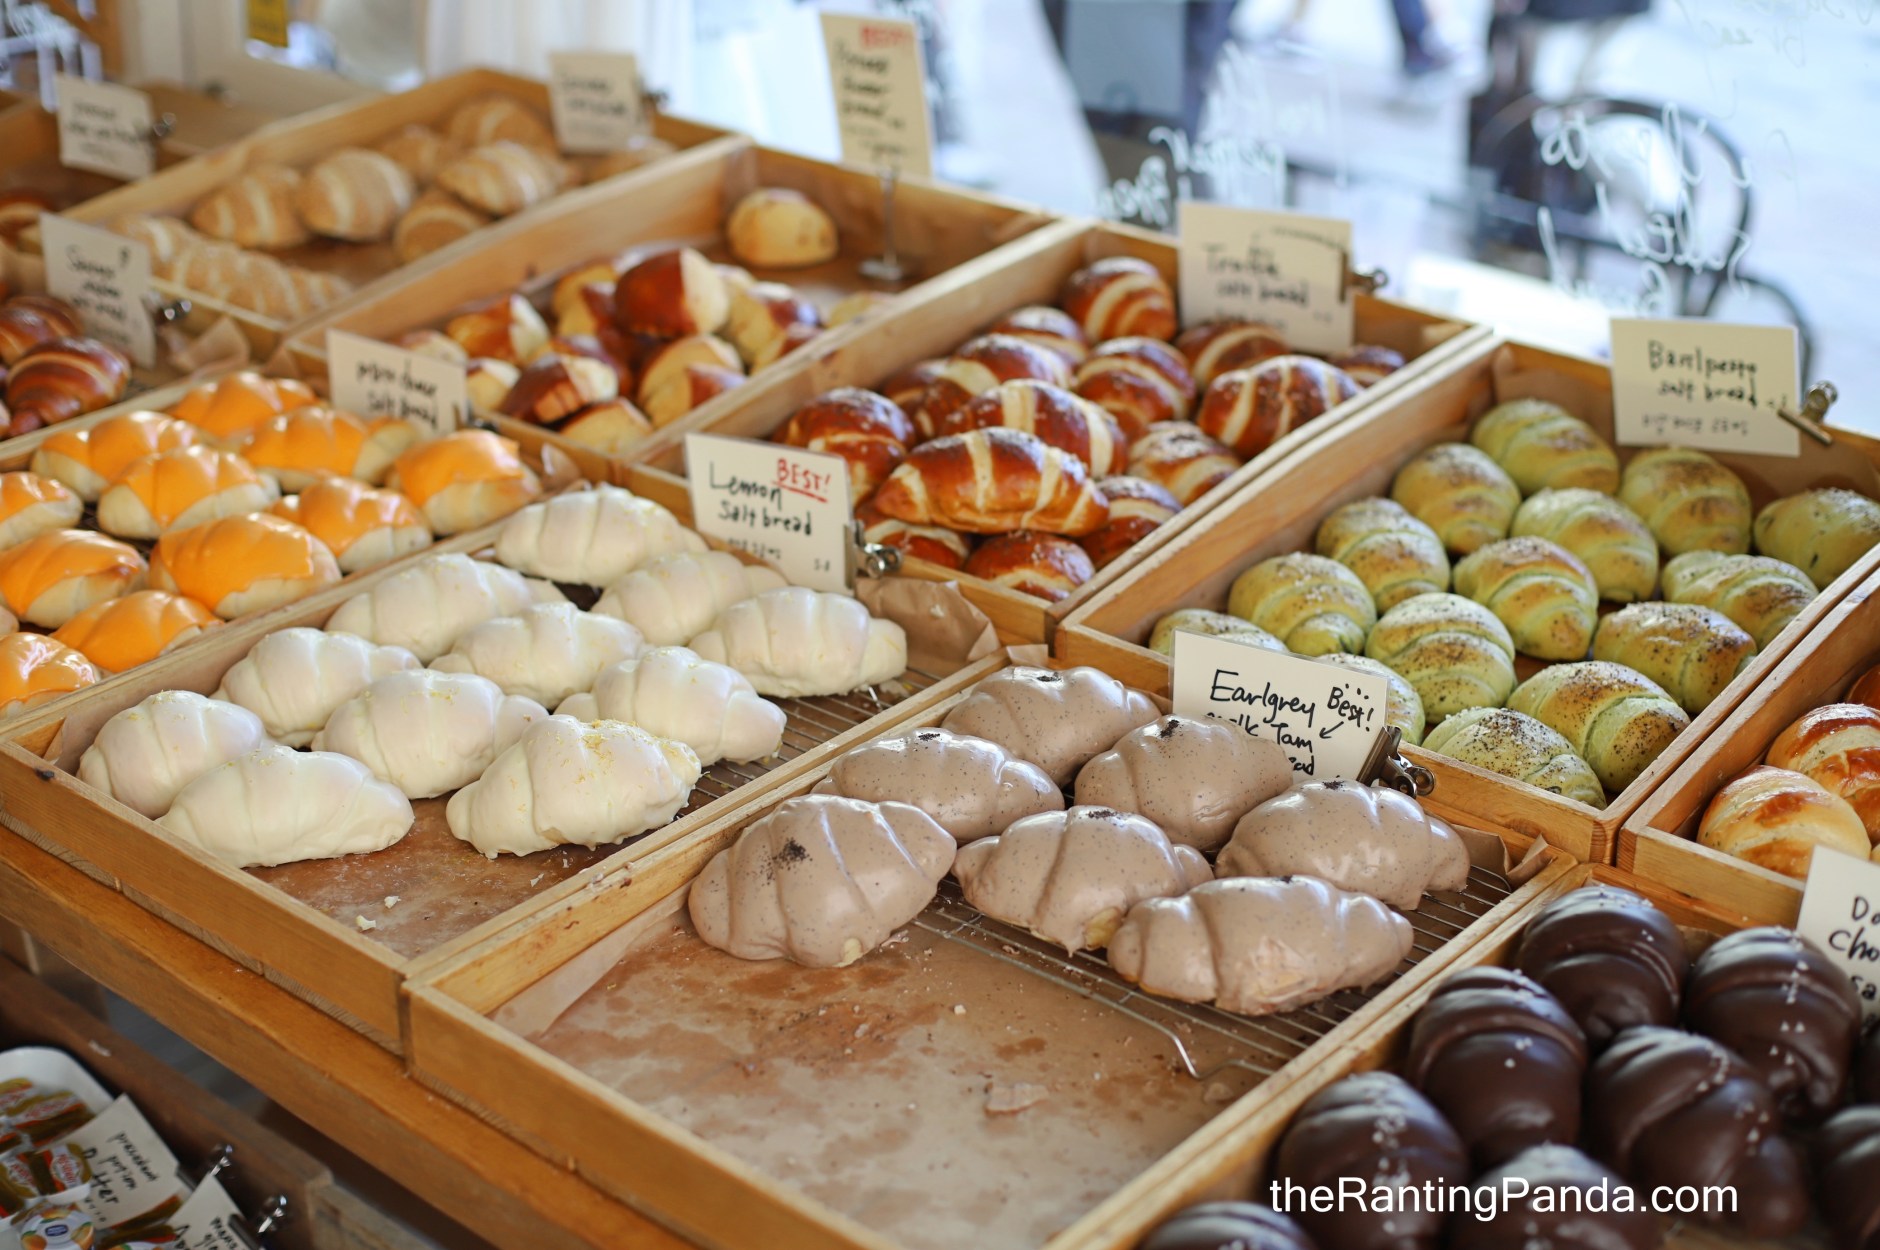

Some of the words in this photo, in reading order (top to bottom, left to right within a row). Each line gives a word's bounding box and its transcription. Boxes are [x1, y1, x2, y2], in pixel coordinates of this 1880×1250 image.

[710, 460, 782, 512] Lemon
[777, 457, 832, 492] BEST!
[718, 500, 756, 528] Salt
[763, 507, 812, 536] bread
[1209, 668, 1316, 728] Earlgrey
[1326, 685, 1375, 732] Best!
